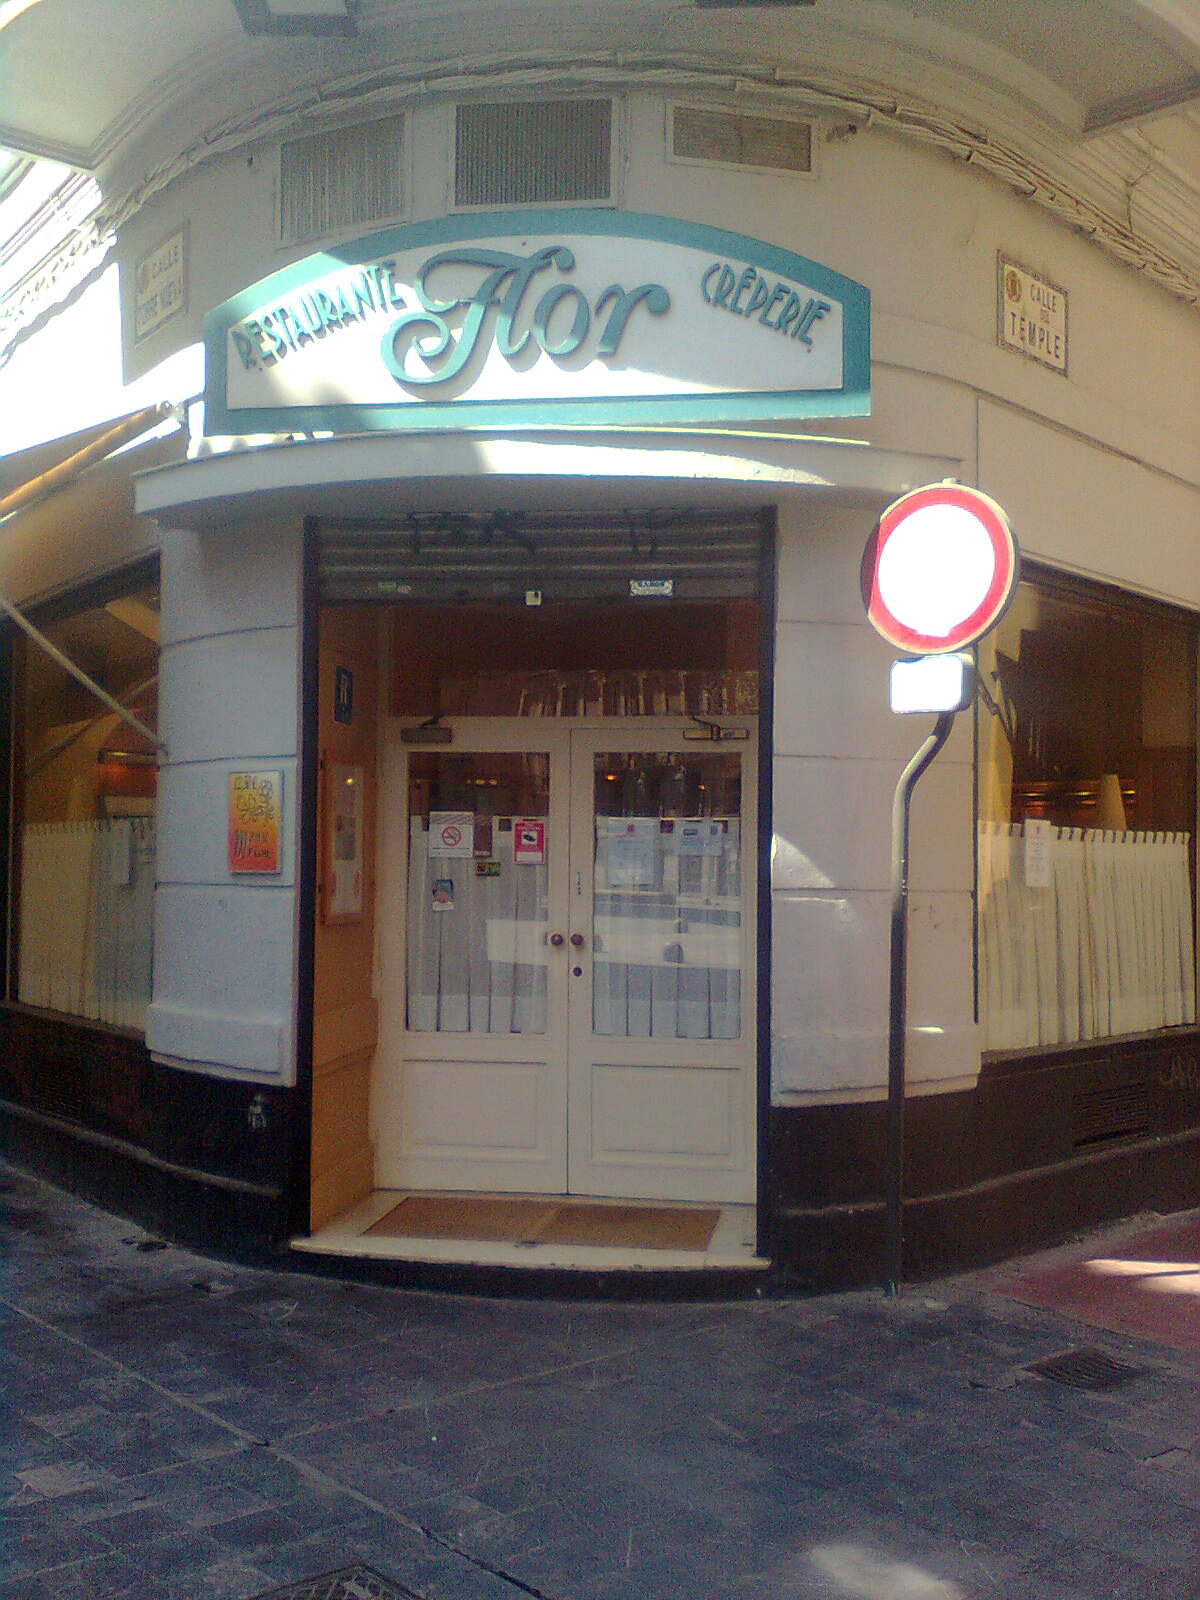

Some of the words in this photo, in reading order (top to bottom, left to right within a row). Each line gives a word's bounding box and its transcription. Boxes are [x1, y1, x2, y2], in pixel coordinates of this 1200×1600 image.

[231, 260, 404, 369] RESTAURANTE
[381, 245, 671, 385] Flor
[1010, 311, 1061, 360] TEMPLE
[1030, 284, 1057, 313] CALLE
